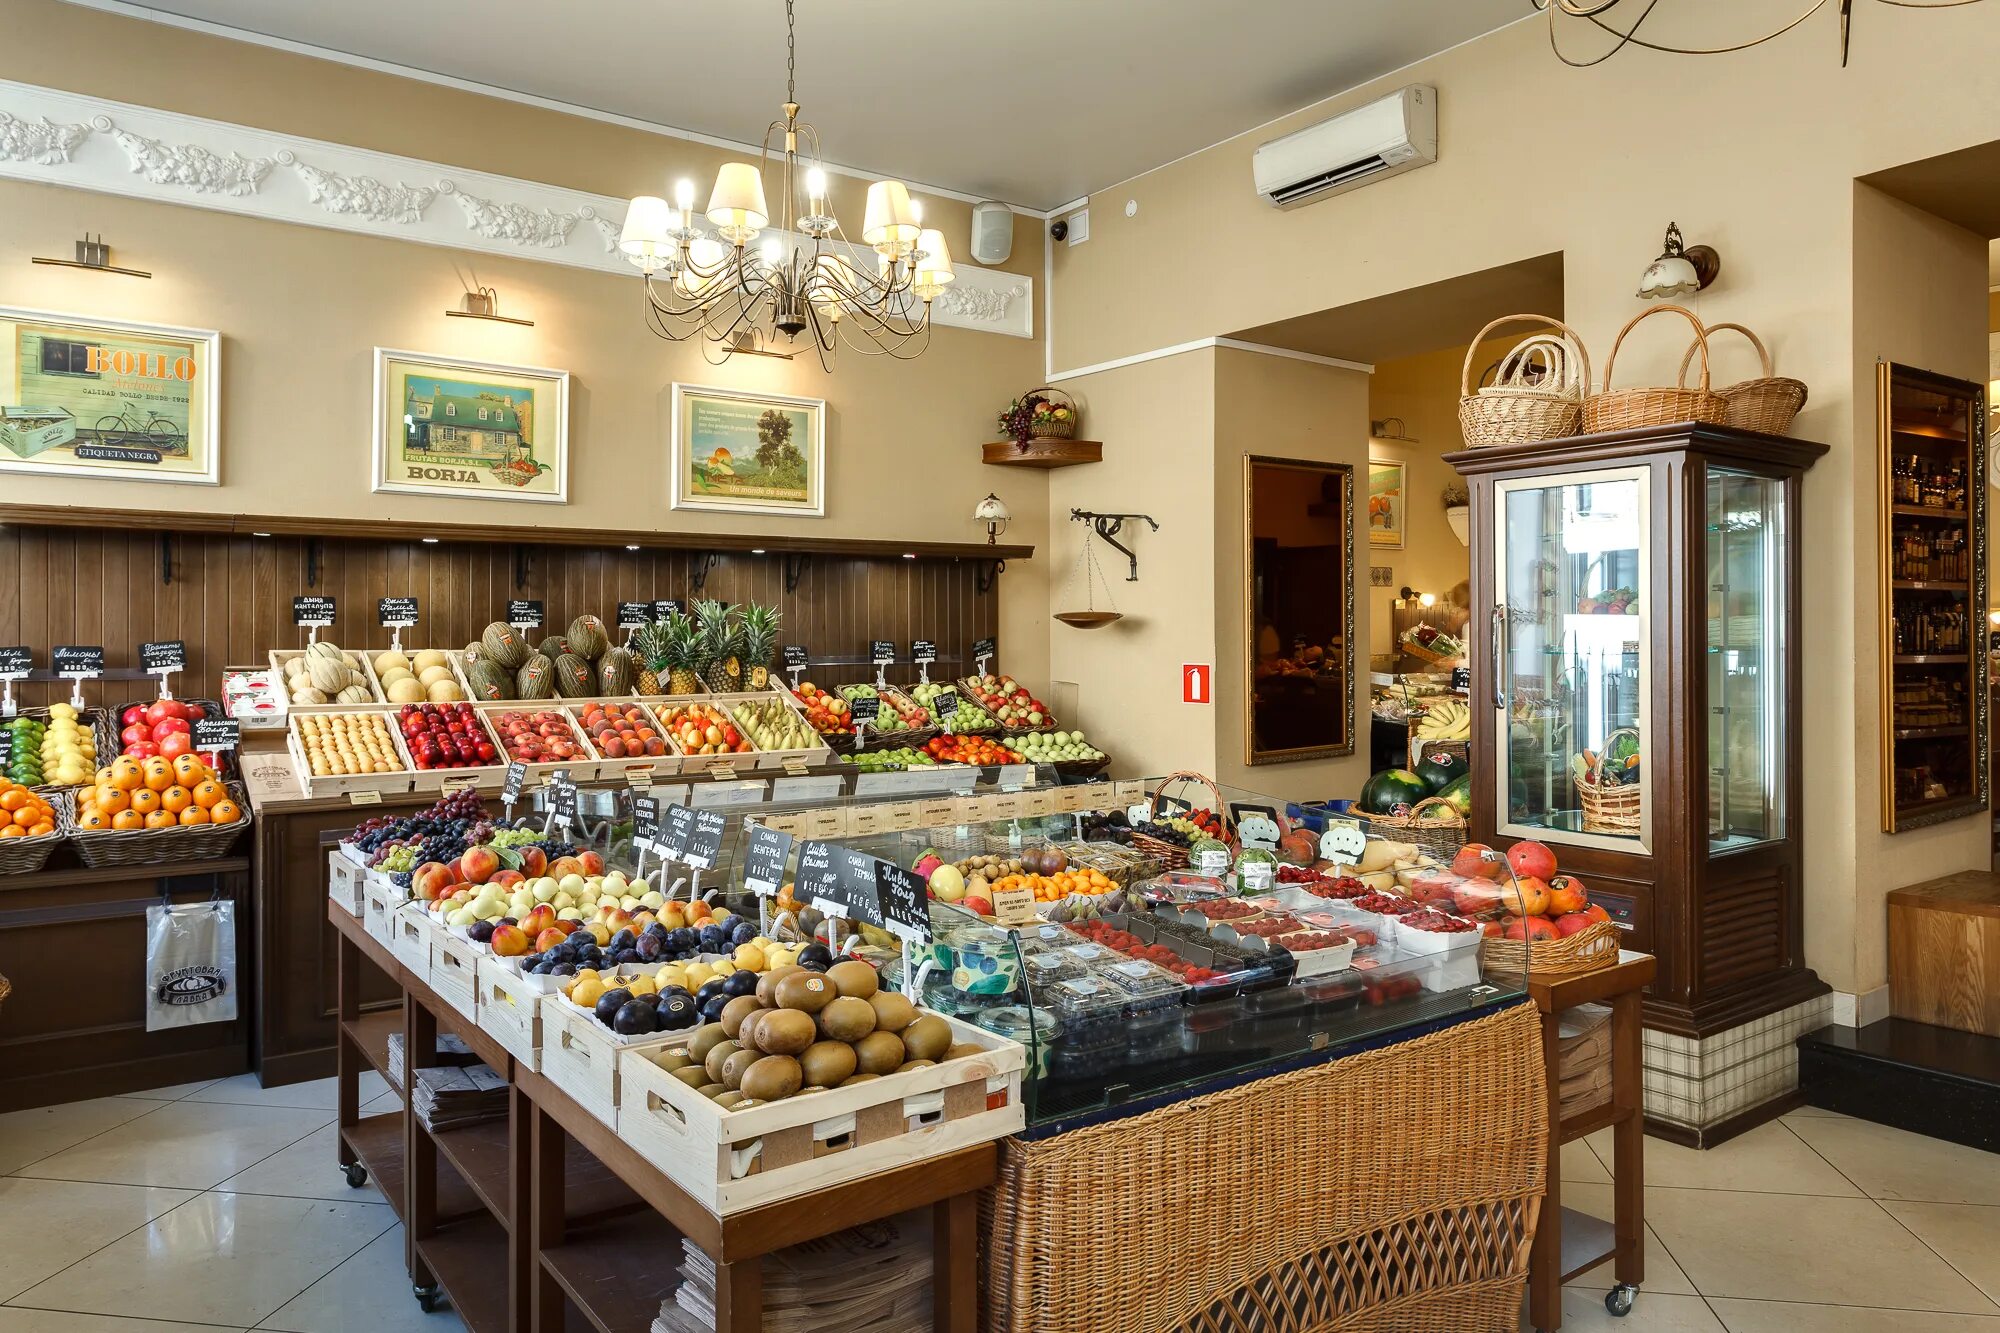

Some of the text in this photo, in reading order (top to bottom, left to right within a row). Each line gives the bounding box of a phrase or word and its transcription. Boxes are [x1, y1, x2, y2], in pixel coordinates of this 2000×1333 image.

[85, 346, 197, 382] BOLLO
[82, 388, 116, 397] CALIDAD
[119, 391, 142, 399] BOLLO
[146, 394, 169, 402] DESDE
[78, 448, 158, 460] ETIQUETA NEGRA
[405, 454, 438, 462] FRUTAS
[407, 466, 481, 483] BORJA
[806, 841, 829, 857] Слива
[848, 855, 865, 868] СЛИВА
[882, 865, 911, 889] Киви
[891, 883, 915, 907] Голд
[161, 965, 222, 982] ФРУКТОВАЯ
[176, 993, 207, 1003] ЛАВКА
